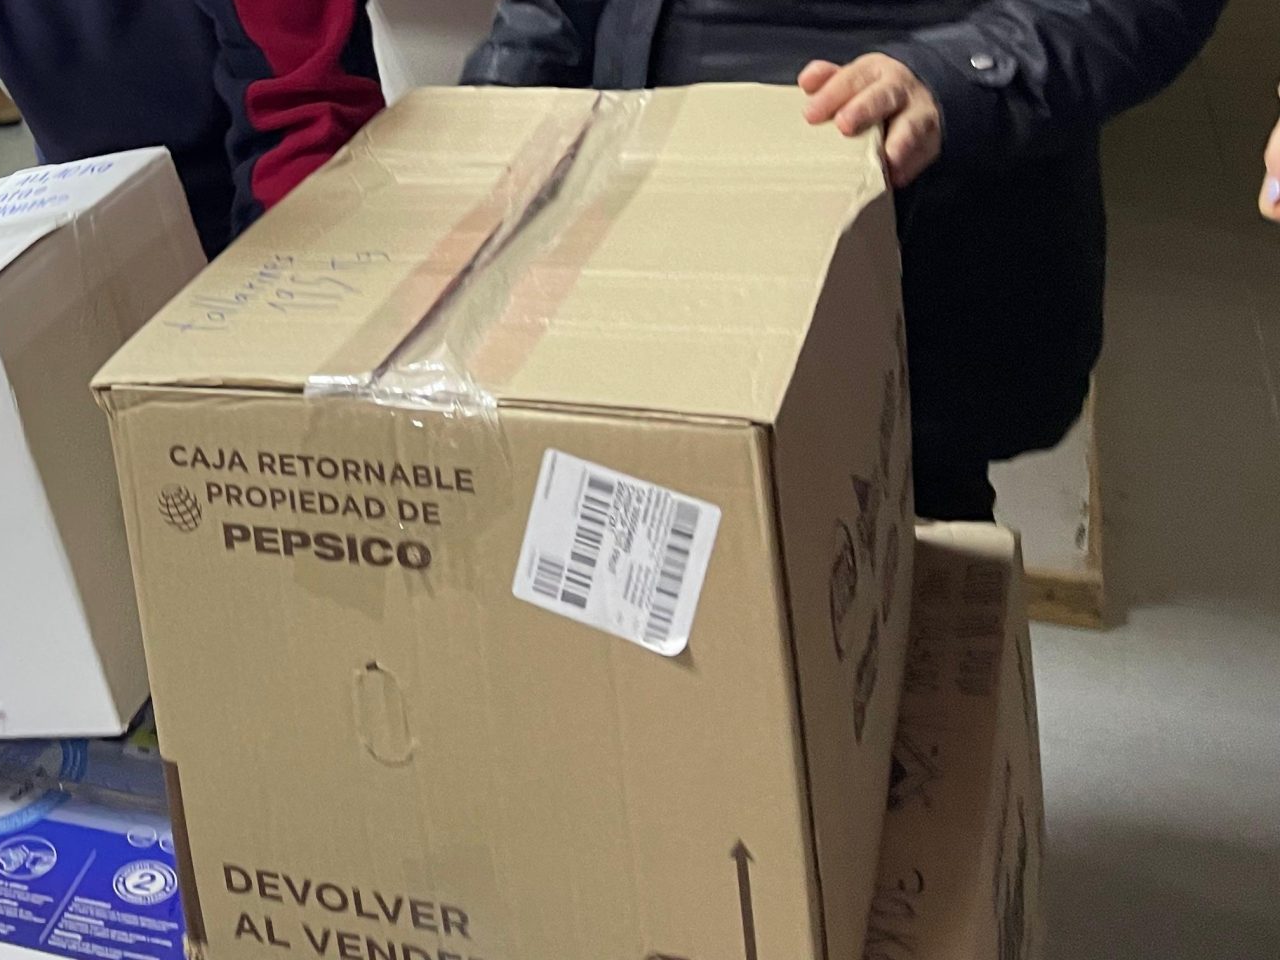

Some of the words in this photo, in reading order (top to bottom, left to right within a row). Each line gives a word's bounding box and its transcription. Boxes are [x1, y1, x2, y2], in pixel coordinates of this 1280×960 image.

[169, 444, 249, 474] CAJA
[257, 450, 476, 494] RETORNABLE
[205, 481, 387, 520] PROPIEDAD
[397, 498, 442, 526] DE
[221, 521, 433, 571] PEPSICO
[222, 862, 473, 940] DEVOLVER
[235, 911, 292, 950] AL
[301, 921, 486, 960] VEND
